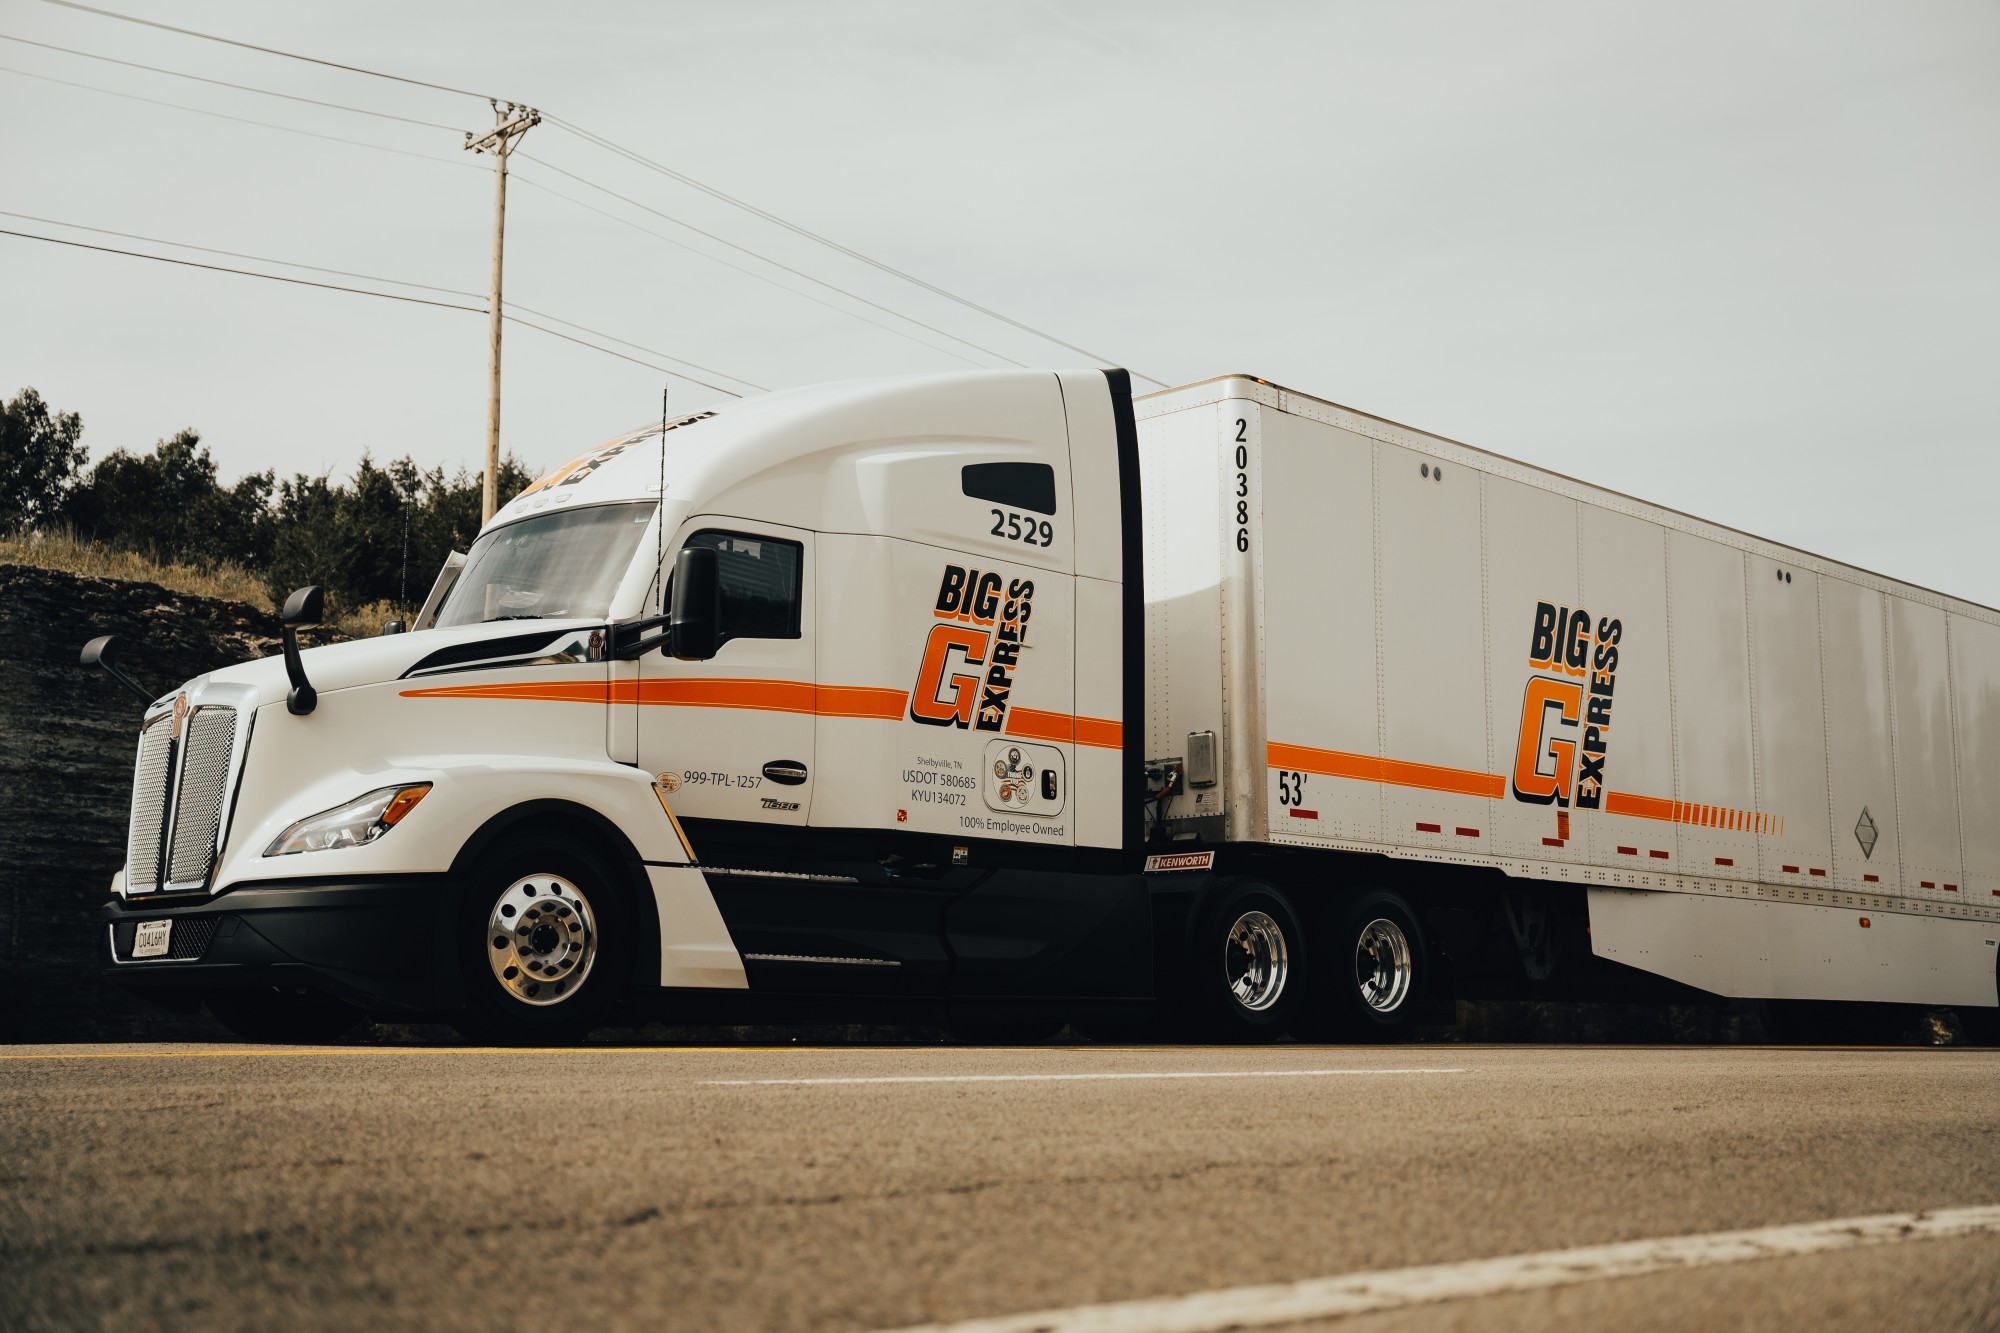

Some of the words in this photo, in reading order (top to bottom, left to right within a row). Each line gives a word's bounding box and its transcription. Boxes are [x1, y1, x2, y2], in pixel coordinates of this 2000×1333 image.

[1235, 418, 1249, 552] 20386
[990, 508, 1053, 547] 2529
[934, 562, 1003, 626] BIG
[973, 577, 1035, 734] EXPRESS
[1528, 598, 1591, 678] BIG
[910, 623, 991, 729] G
[1574, 616, 1622, 812] EXPRESS
[1512, 674, 1584, 808] G
[684, 770, 762, 789] 999-TPL-1257
[902, 770, 938, 785] USDOT
[940, 774, 976, 789] 580685
[917, 757, 953, 770] Shelbyville,
[953, 760, 963, 770] TN
[760, 797, 801, 811] T680
[911, 789, 966, 806] KYU134072
[1279, 770, 1308, 806] 53'
[959, 816, 985, 829] 100%
[986, 818, 1031, 835] Employee
[1032, 823, 1064, 836] Owned
[1160, 855, 1209, 868] KENWORTH
